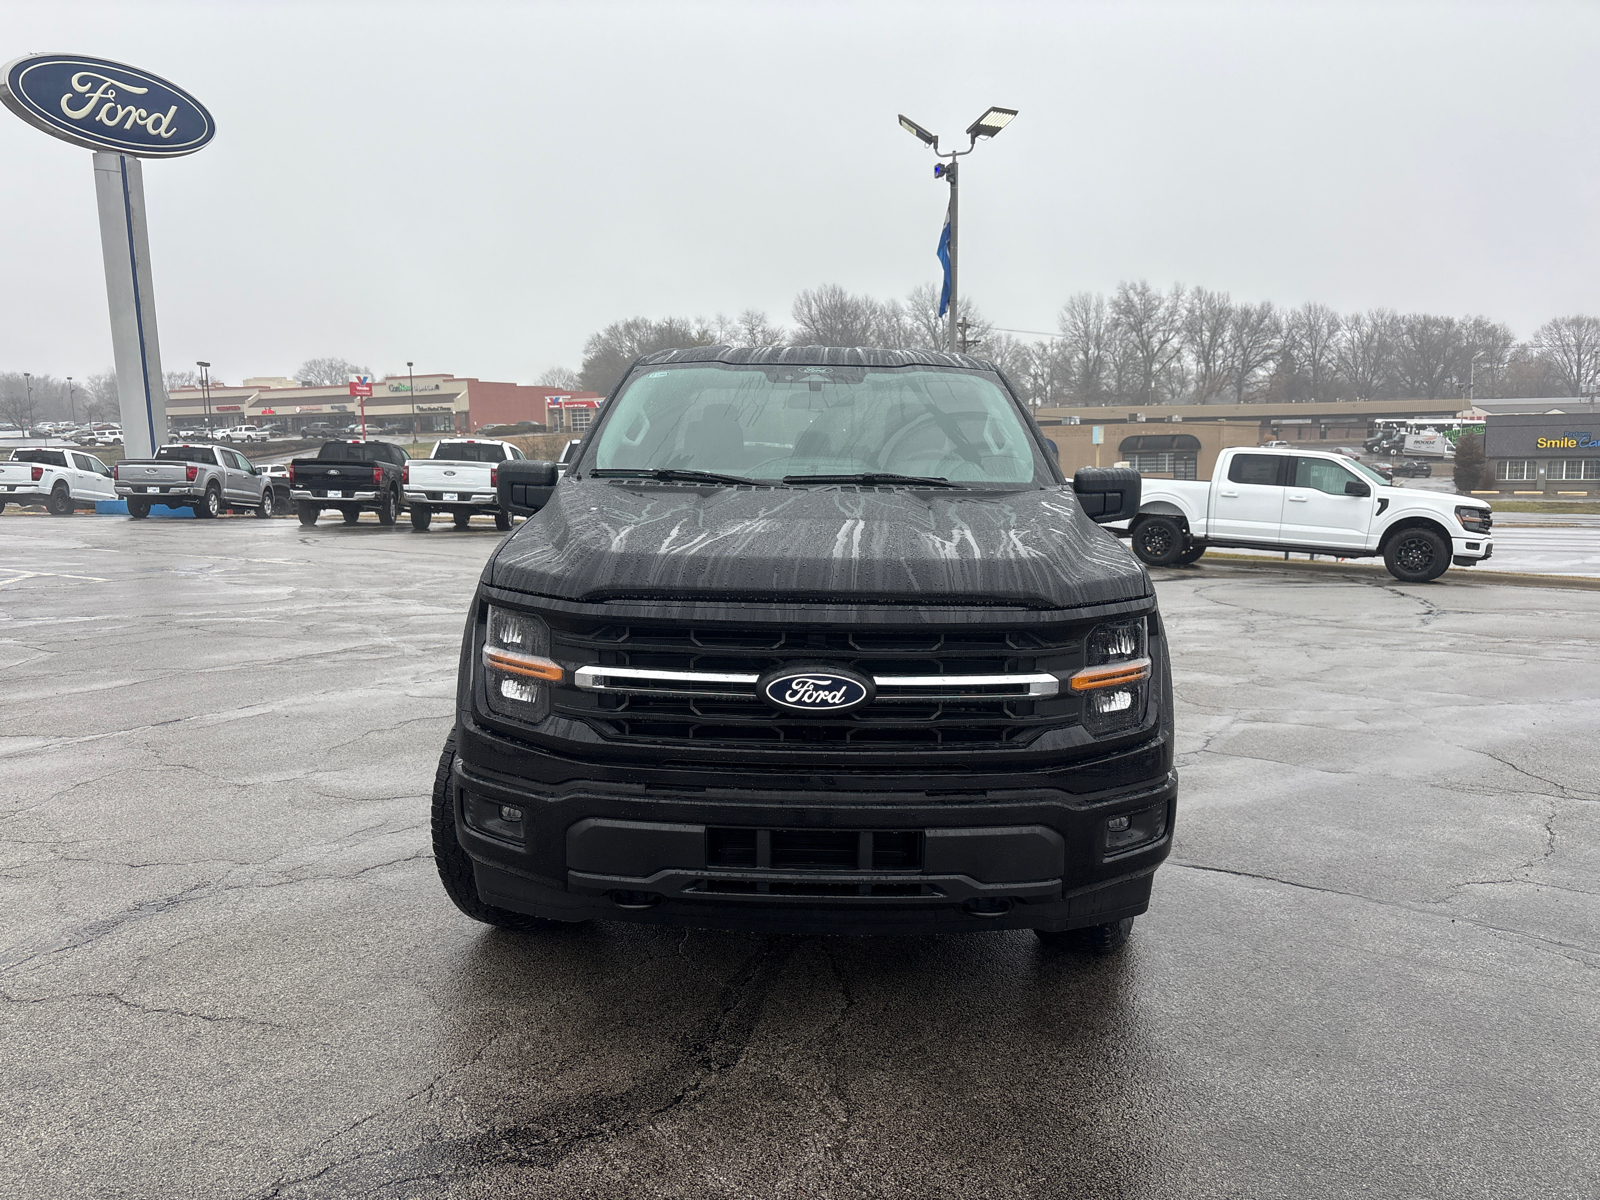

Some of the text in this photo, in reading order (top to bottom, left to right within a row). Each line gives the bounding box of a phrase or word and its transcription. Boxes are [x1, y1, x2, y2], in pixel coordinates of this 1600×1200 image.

[60, 71, 178, 139] Ford
[1537, 437, 1577, 448] Smile
[785, 678, 848, 704] Ford
